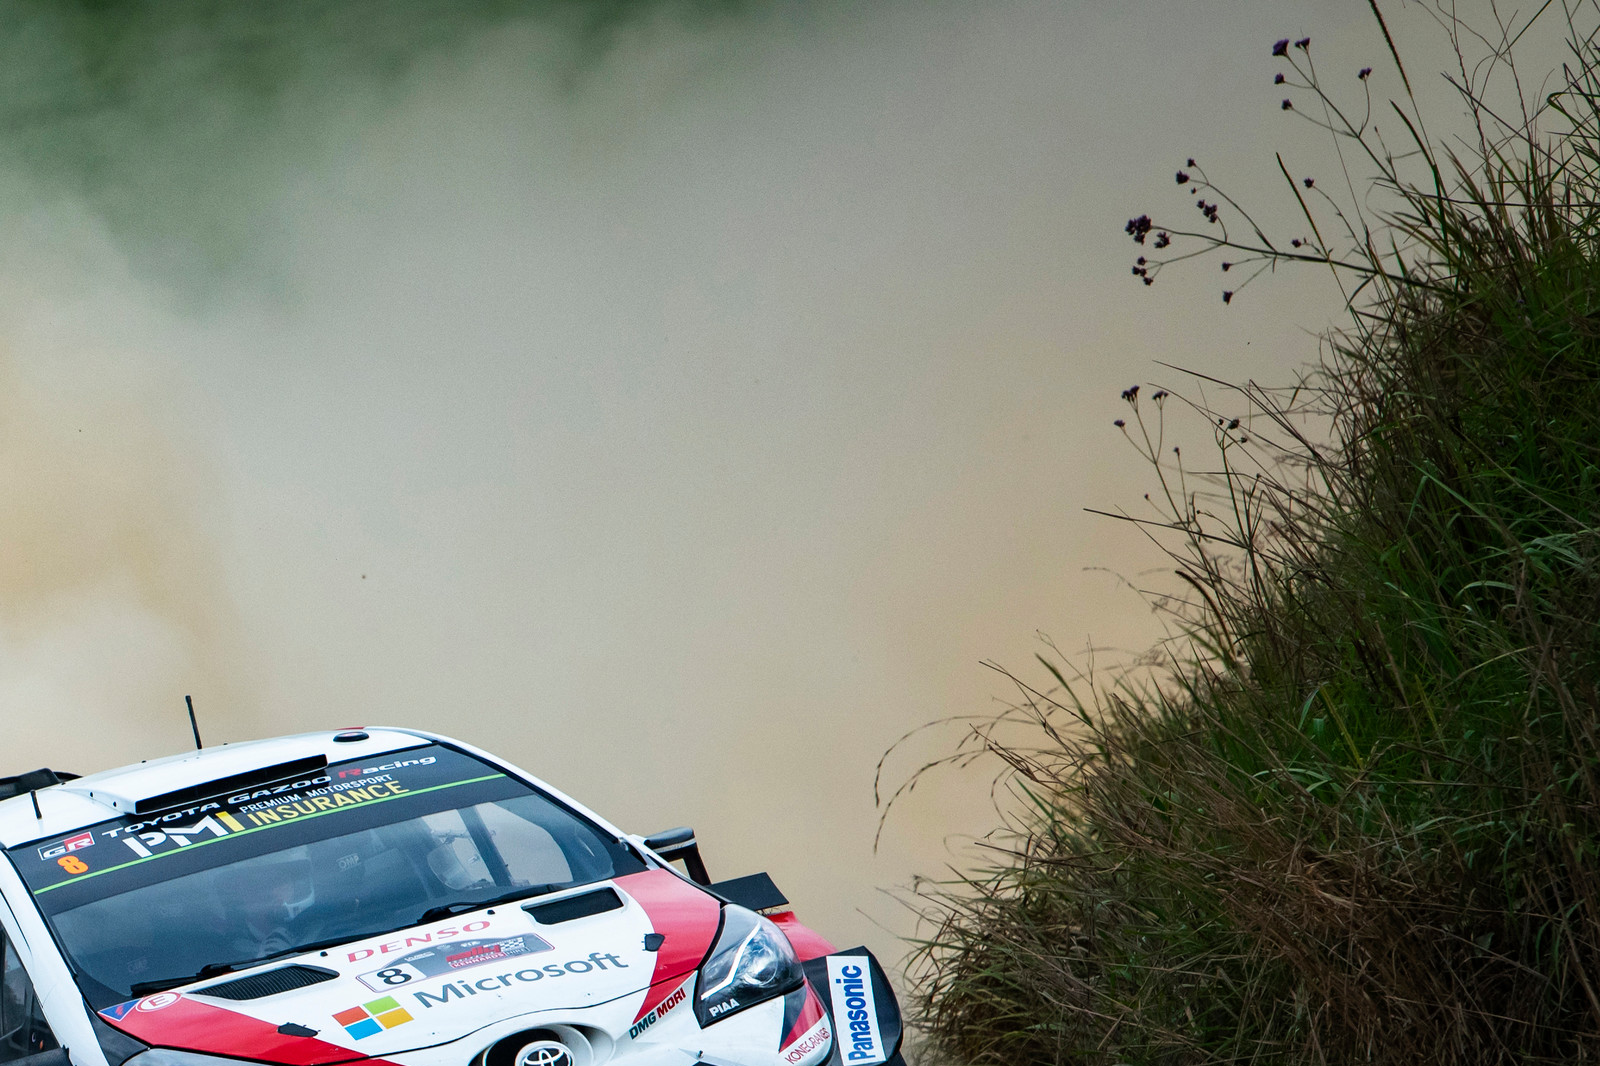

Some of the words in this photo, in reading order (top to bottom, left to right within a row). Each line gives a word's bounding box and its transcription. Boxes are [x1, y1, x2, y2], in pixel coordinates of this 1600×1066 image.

[101, 802, 221, 838] TOYOTA
[227, 775, 332, 804] GAZOO
[338, 756, 437, 778] Racing
[239, 794, 302, 814] PREMIUM
[306, 774, 393, 798] MOTORSPORT
[247, 780, 410, 826] INSURANCE
[43, 837, 93, 859] GR
[122, 811, 245, 858] PMI
[57, 855, 89, 874] 8
[347, 920, 491, 963] DENSO
[453, 952, 505, 968] KENNARDS
[376, 968, 412, 985] 8
[413, 951, 629, 1008] Microsoft
[629, 1014, 656, 1041] DMG
[656, 987, 687, 1018] MORI
[709, 998, 740, 1017] PIAA
[836, 965, 876, 1061] Panasonic
[784, 1027, 831, 1065] KONECRANES
